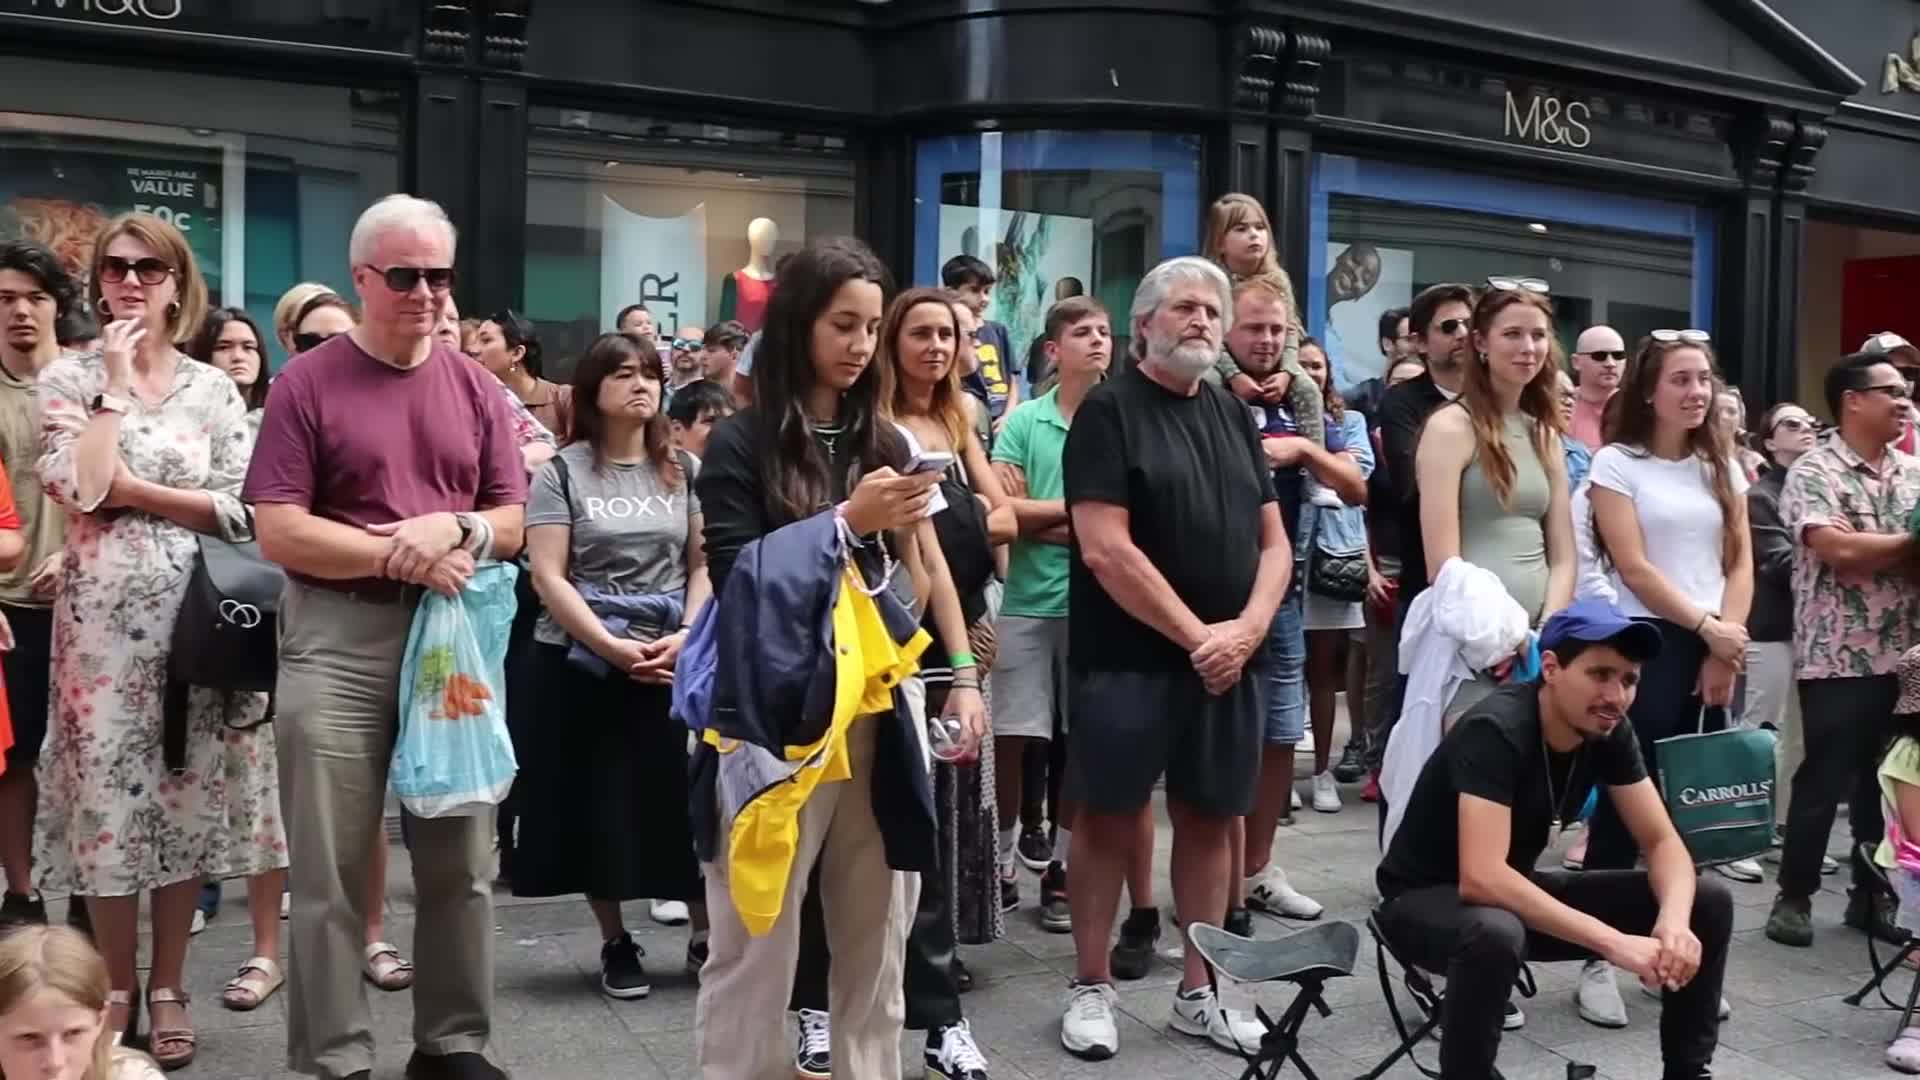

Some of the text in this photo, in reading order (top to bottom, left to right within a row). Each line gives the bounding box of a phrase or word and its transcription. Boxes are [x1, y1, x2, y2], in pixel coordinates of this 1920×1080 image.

[1505, 90, 1591, 148] M&S
[131, 180, 195, 197] VALUE
[585, 495, 674, 519] ROXY
[1680, 781, 1770, 805] CARROLLS
